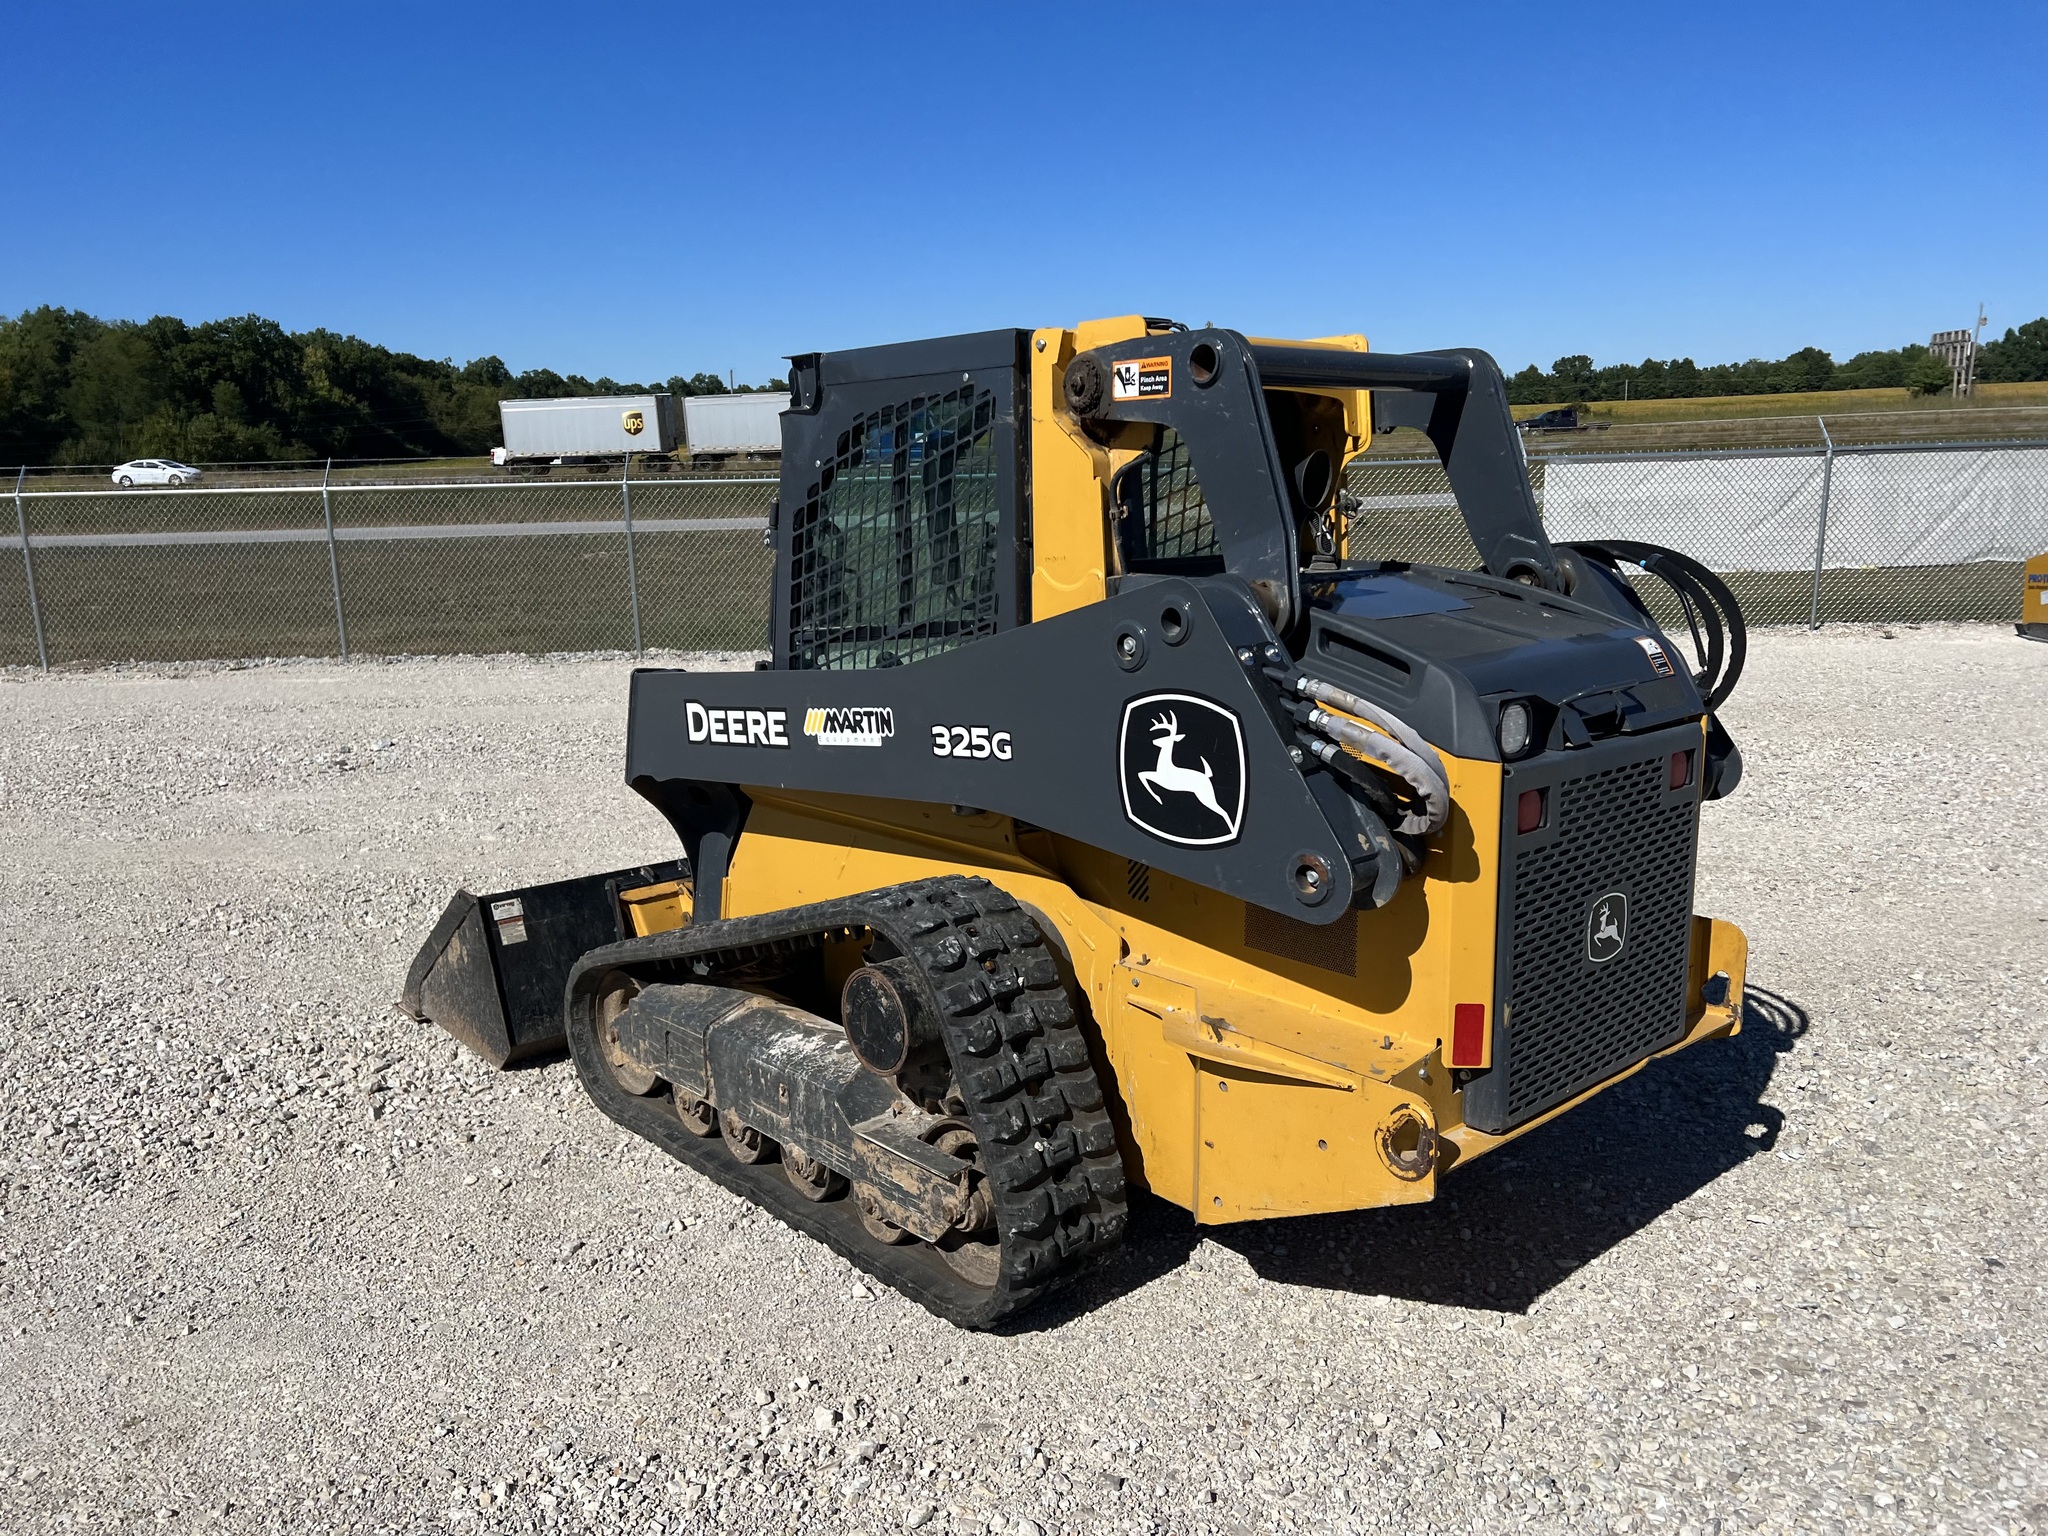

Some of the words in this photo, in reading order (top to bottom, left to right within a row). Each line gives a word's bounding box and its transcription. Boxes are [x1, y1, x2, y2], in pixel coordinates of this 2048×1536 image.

[624, 418, 643, 433] ups
[685, 702, 789, 746] DEERE
[823, 710, 893, 734] MARTIN
[818, 735, 881, 744] Equipment
[931, 726, 1012, 760] 325G
